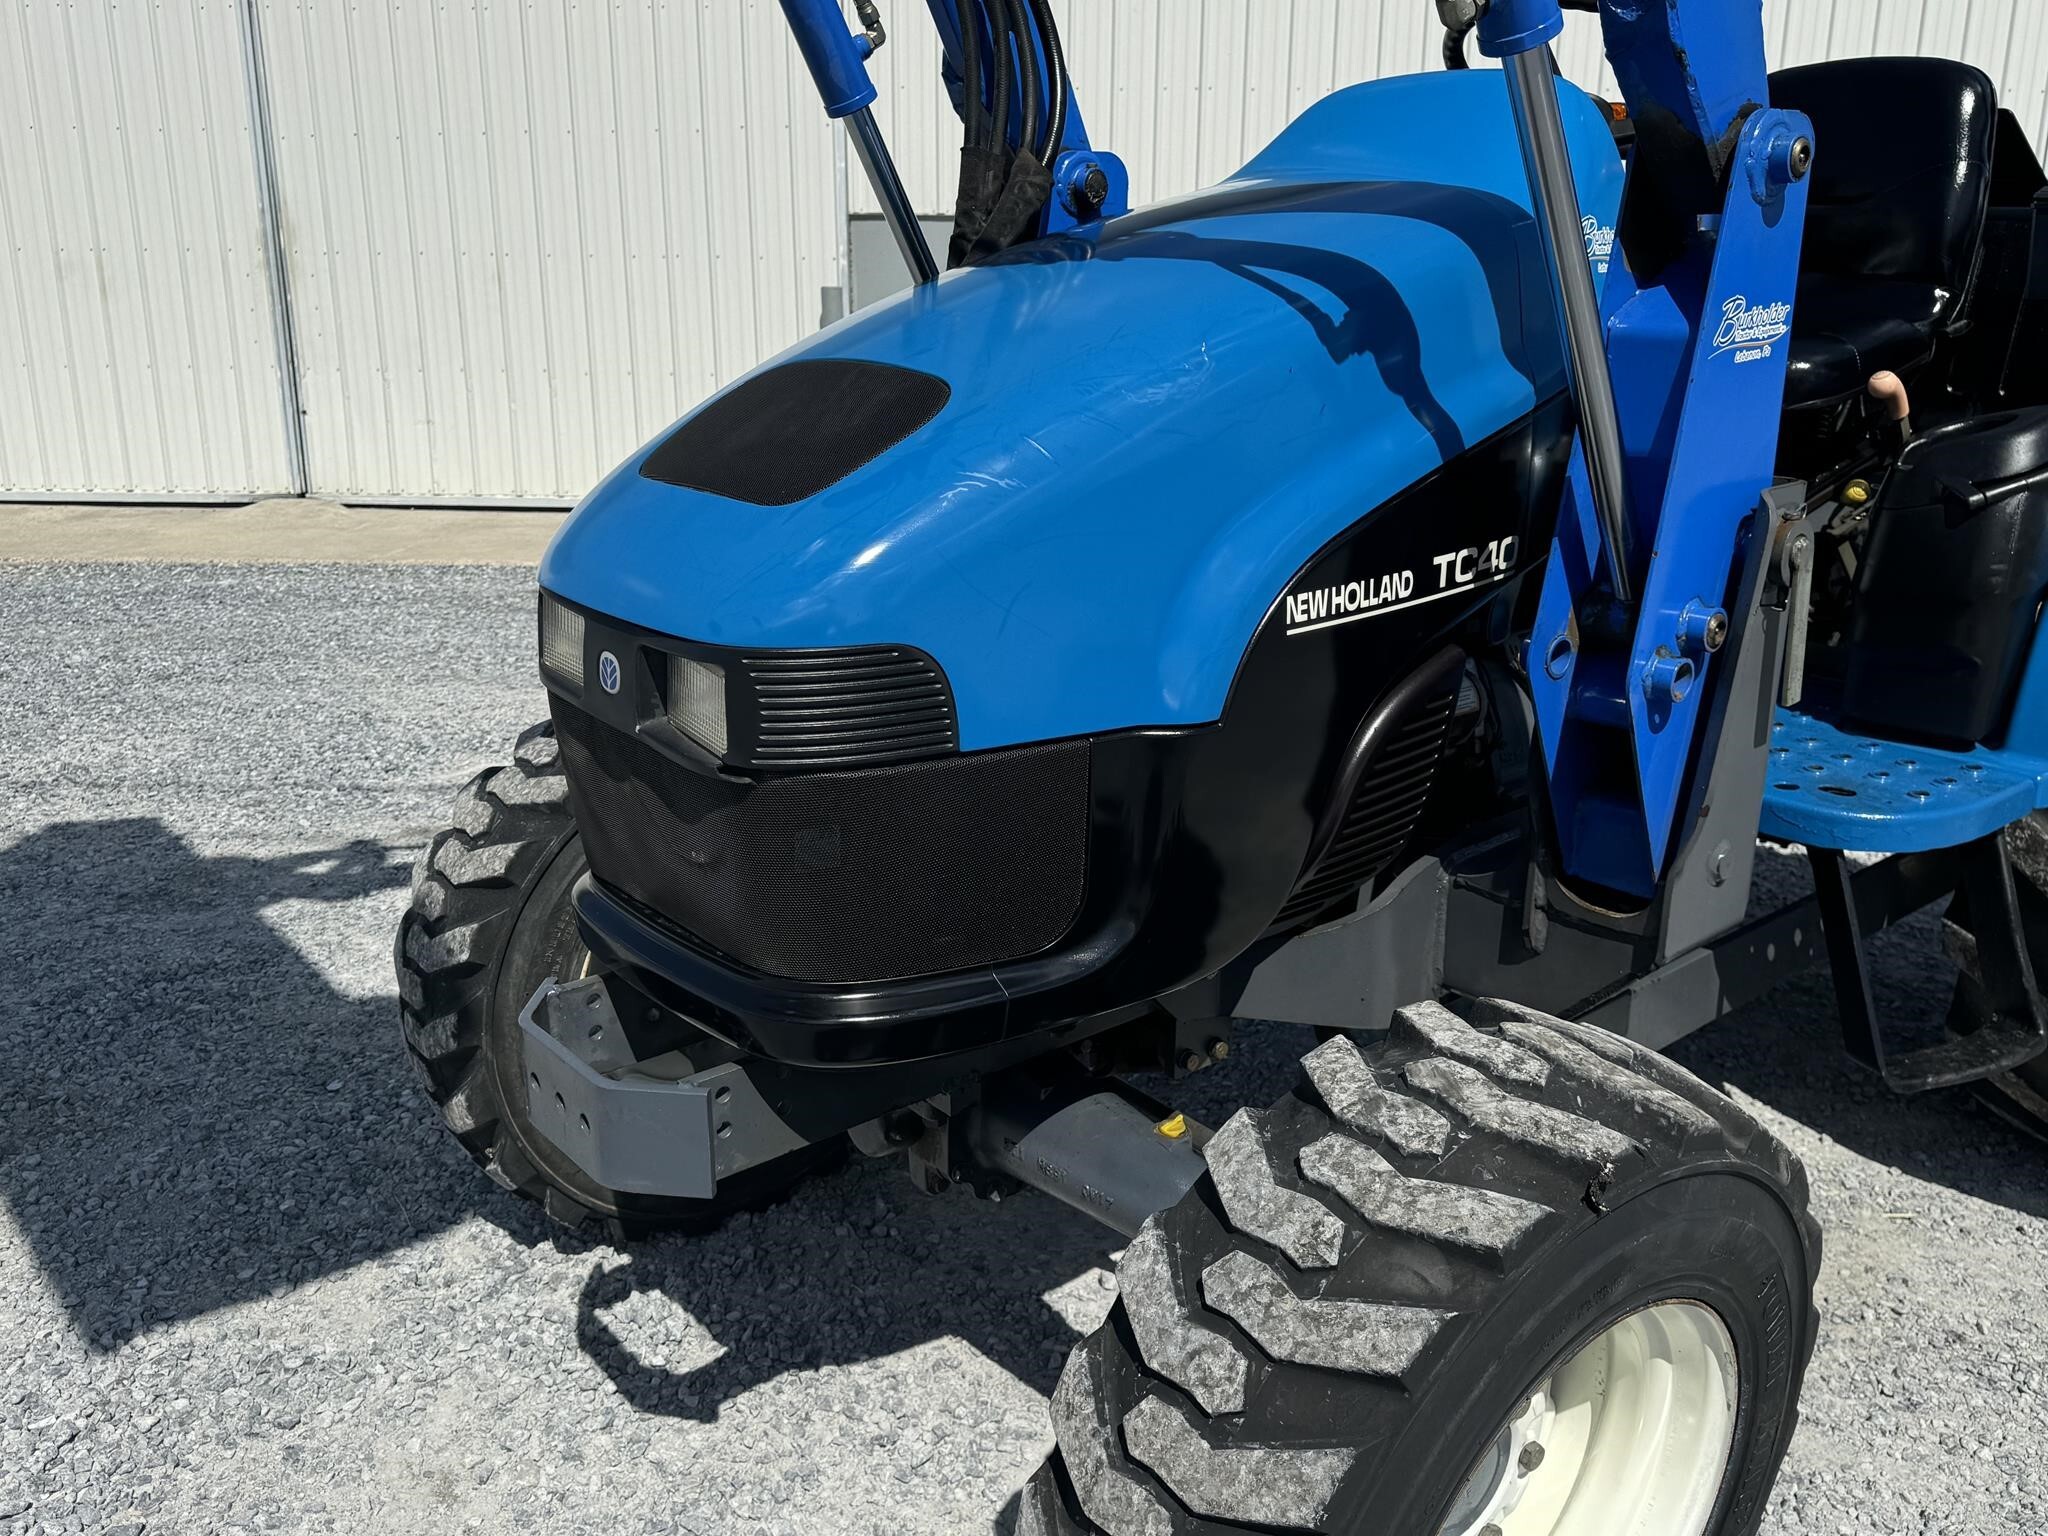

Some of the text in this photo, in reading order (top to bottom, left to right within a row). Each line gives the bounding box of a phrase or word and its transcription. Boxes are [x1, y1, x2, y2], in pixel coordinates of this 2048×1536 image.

[1581, 214, 1616, 257] Burkho
[1713, 294, 1790, 346] Burkholder
[1286, 535, 1519, 625] NEW HOLLAND TC40
